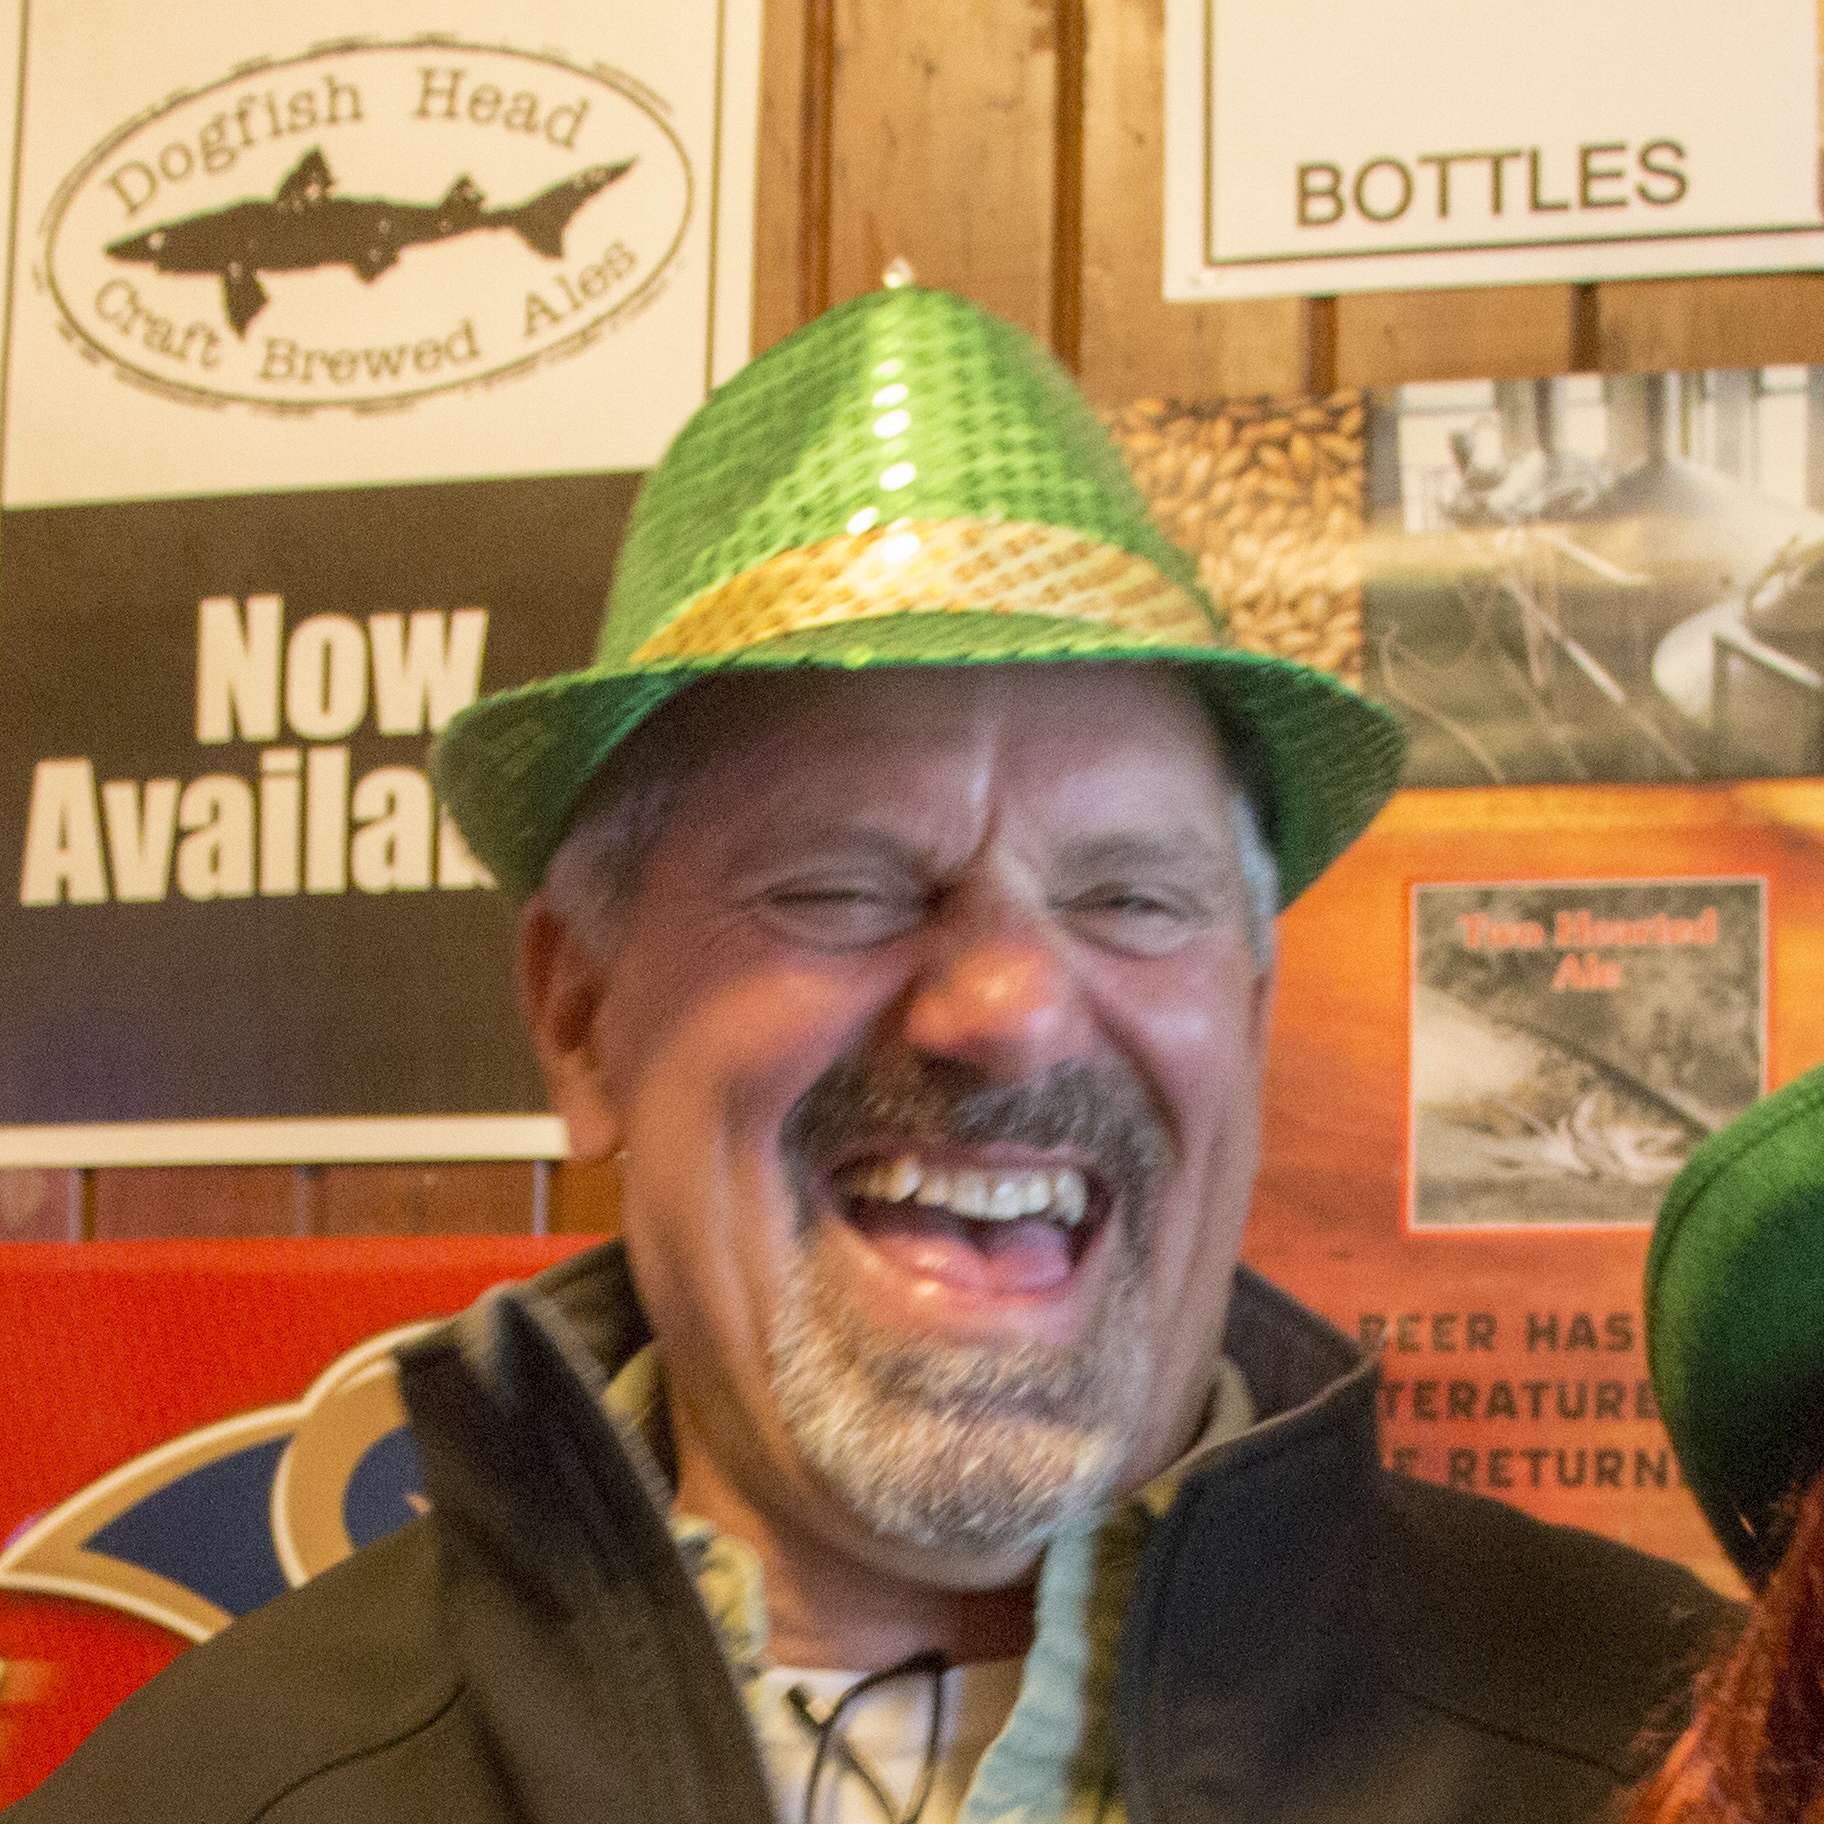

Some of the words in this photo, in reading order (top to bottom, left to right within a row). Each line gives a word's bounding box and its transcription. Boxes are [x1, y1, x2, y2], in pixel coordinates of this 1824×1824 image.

[103, 73, 364, 216] Dogfish
[412, 66, 591, 151] Head
[1295, 139, 1690, 229] BOTTLES
[94, 278, 223, 369] Craft
[258, 316, 480, 385] Brewed
[522, 240, 638, 337] Ales
[195, 593, 488, 745] Now
[1358, 1311, 1499, 1352] BEER
[1524, 1311, 1635, 1352] HAS
[1377, 1378, 1662, 1421] TERATURE
[1447, 1447, 1670, 1490] RETURN
